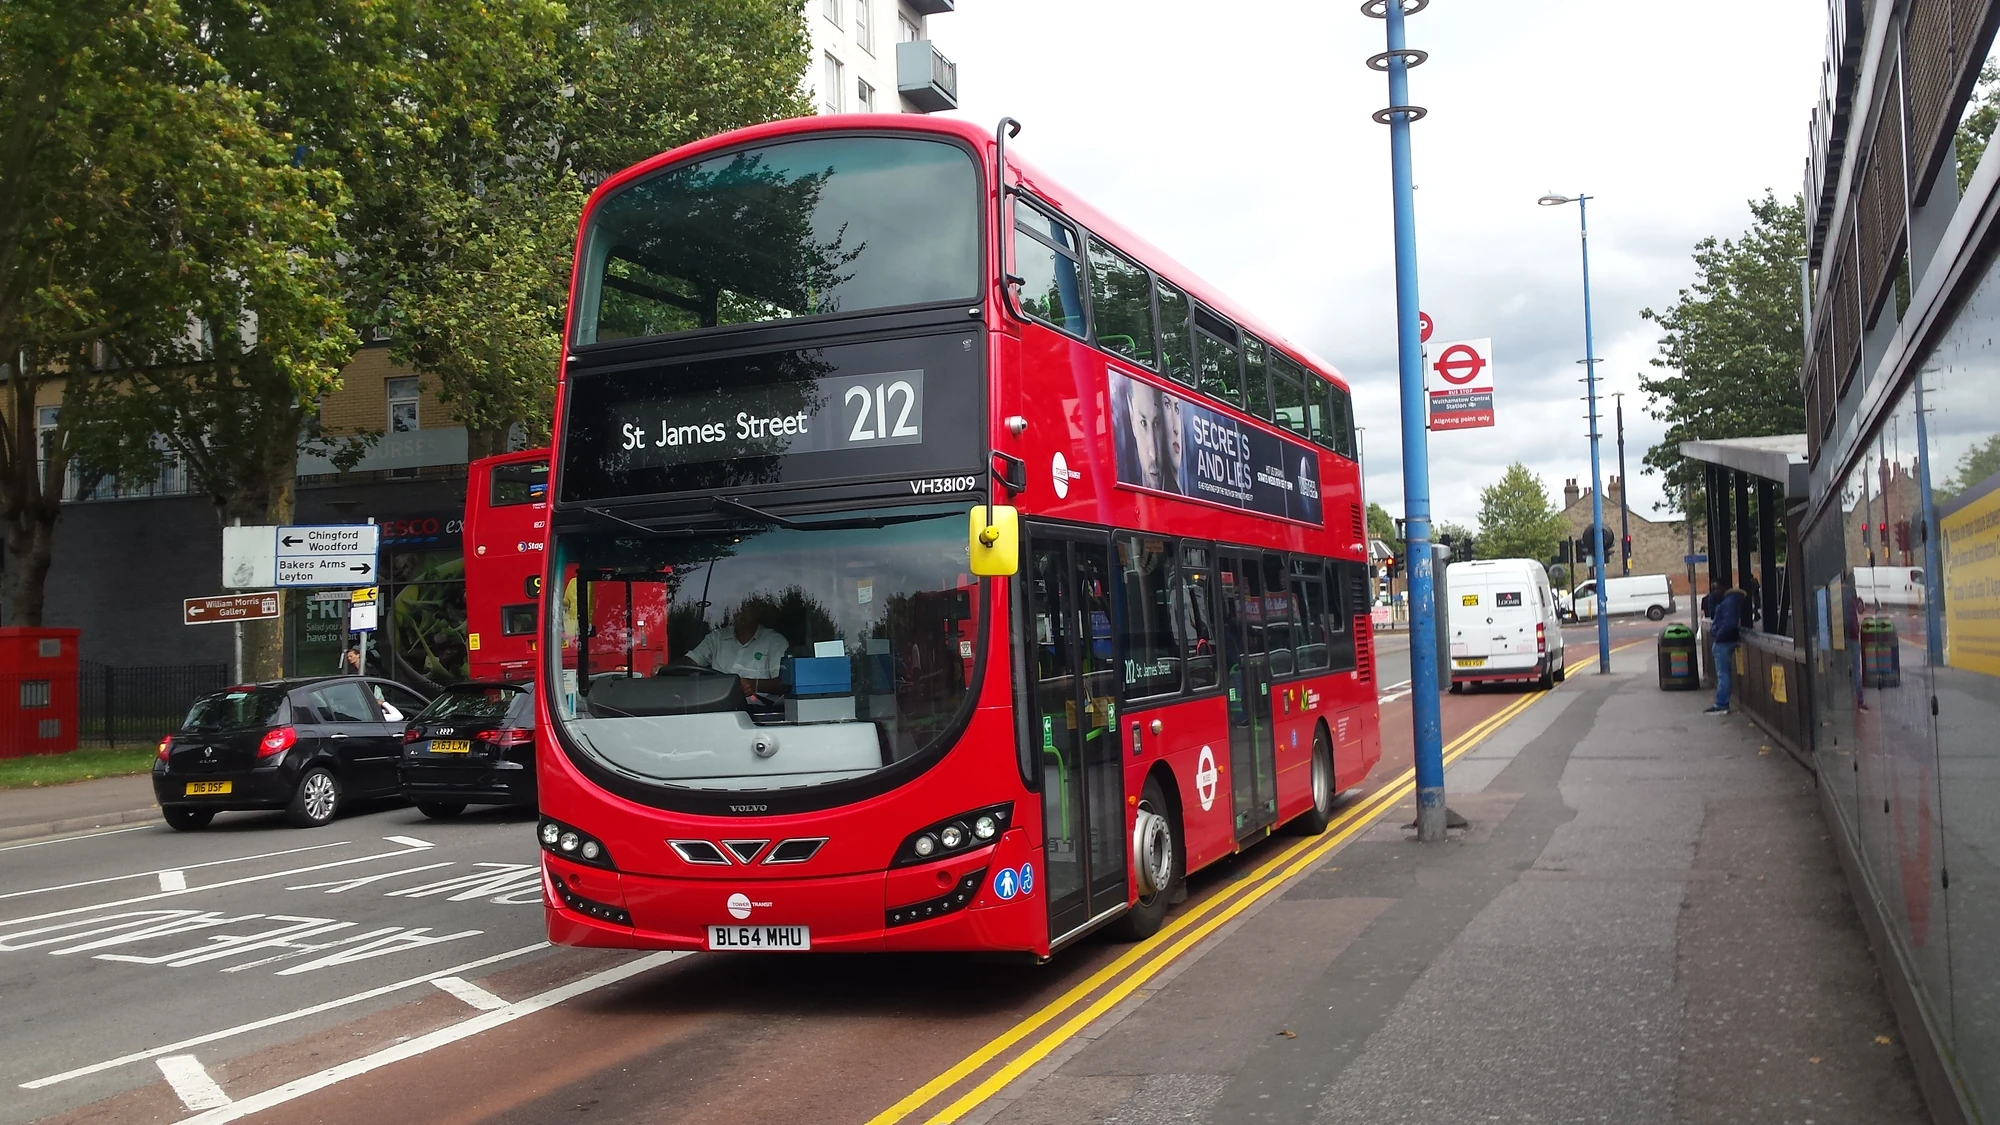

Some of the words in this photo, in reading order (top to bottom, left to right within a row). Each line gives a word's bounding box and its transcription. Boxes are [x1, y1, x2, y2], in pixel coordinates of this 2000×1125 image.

[1432, 397, 1469, 405] Walthamstow
[622, 423, 646, 451] St
[655, 419, 726, 448] James
[735, 410, 808, 440] Street
[844, 380, 919, 442] 212
[1477, 414, 1490, 422] only
[1192, 415, 1251, 461] SECRETS
[1197, 449, 1225, 483] AND
[1227, 460, 1252, 490] LIES
[910, 475, 976, 496] VH38109
[379, 517, 440, 537] ESCO
[308, 531, 359, 541] Chingford
[308, 542, 358, 551] Woodford
[279, 560, 315, 570] Bakers
[319, 560, 346, 568] Arms
[279, 572, 313, 582] Leyton
[205, 600, 233, 609] William
[234, 597, 260, 606] Morris
[219, 608, 247, 616] Gallery
[306, 622, 326, 632] Salad
[326, 624, 338, 632] you
[306, 633, 327, 642] have
[328, 633, 338, 641] to
[1124, 659, 1136, 684] 212
[1143, 662, 1158, 677] James
[1157, 661, 1171, 675] Street
[431, 741, 451, 750] EX63
[207, 782, 224, 792] DSF
[729, 803, 768, 813] VOLVO
[285, 861, 541, 905] NLY
[715, 927, 761, 947] BL64
[766, 927, 802, 947] MHU
